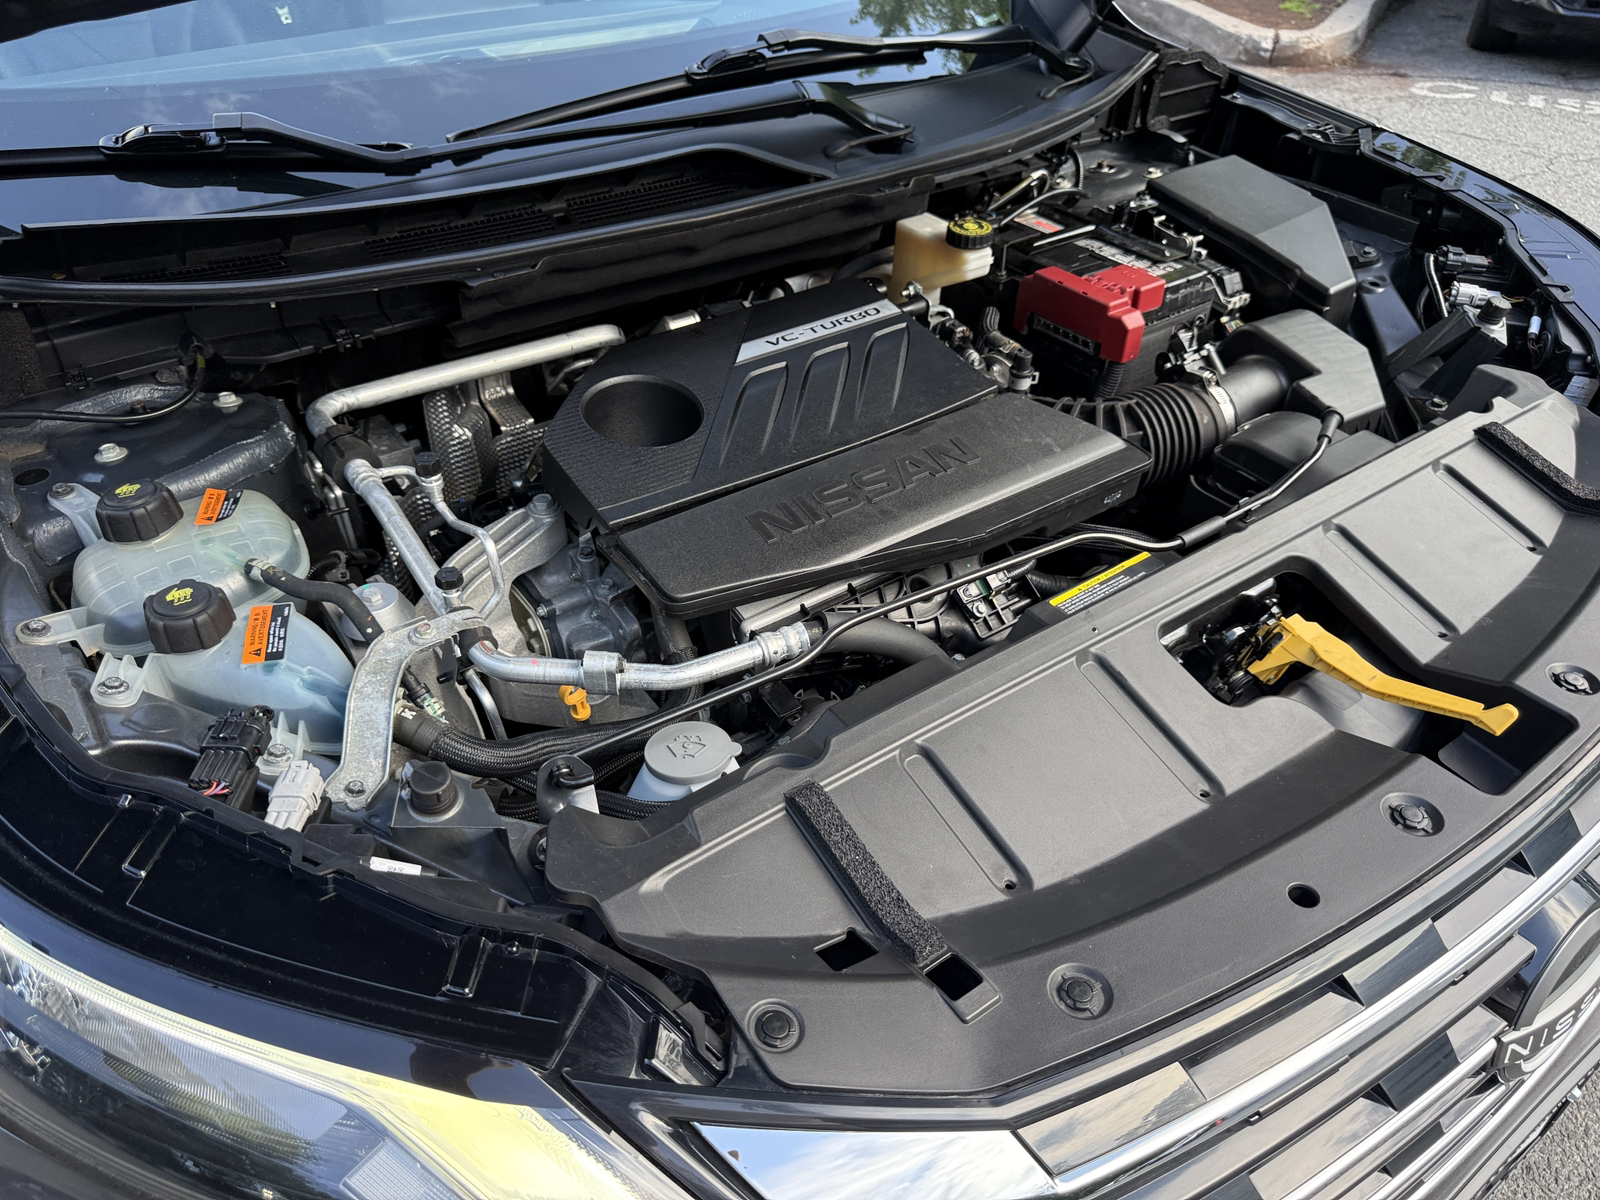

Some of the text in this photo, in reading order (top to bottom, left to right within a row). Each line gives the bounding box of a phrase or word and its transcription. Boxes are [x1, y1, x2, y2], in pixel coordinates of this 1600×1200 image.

[764, 307, 881, 347] VC-TURBO
[744, 437, 982, 544] NISSAN
[250, 624, 259, 646] WARNING
[1503, 986, 1600, 1064] NISS
